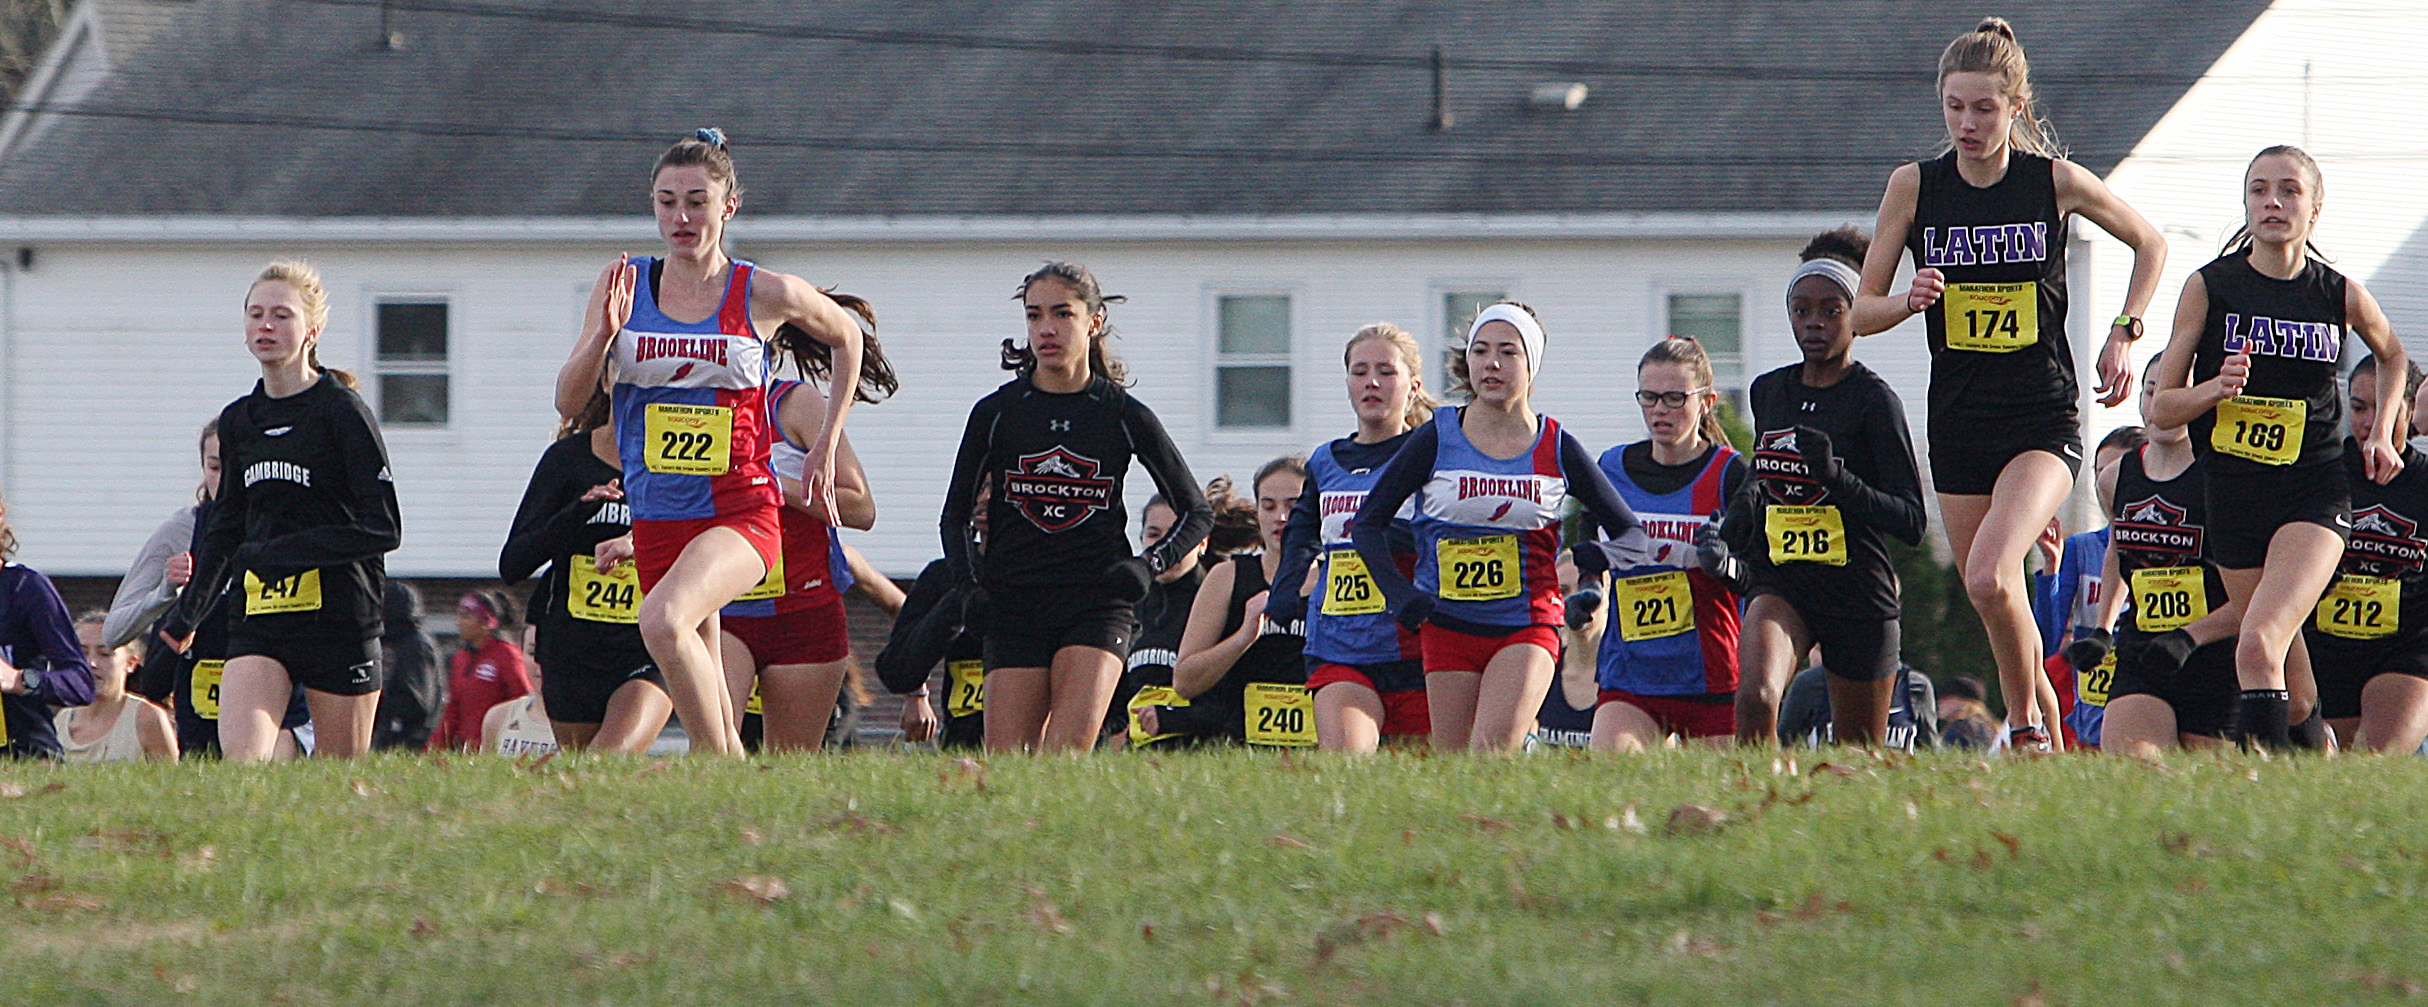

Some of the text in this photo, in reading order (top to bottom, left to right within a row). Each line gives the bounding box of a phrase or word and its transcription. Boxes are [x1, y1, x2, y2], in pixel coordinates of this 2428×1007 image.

[1924, 222, 2047, 265] LATIN
[1964, 310, 2019, 338] 174
[636, 336, 728, 367] BROOKLINE
[2224, 313, 2340, 363] LATIN
[661, 431, 713, 460] 222
[2234, 421, 2286, 451] 169
[244, 461, 311, 488] CAMBRIDGE
[1755, 459, 1809, 475] BROCKT
[1011, 482, 1106, 499] BROCKTON
[1458, 476, 1541, 505] BROOKLINE
[1785, 484, 1804, 496] XC
[1043, 504, 1066, 518] XC
[1782, 529, 1829, 555] 216
[2115, 530, 2194, 547] BROCKTON
[2346, 539, 2420, 560] OCKTON
[1454, 560, 1504, 588] 226
[2360, 562, 2381, 573] XC
[585, 581, 634, 610] 244
[1334, 574, 1370, 601] 225
[1634, 597, 1677, 627] 221
[2145, 591, 2191, 619] 208
[2333, 598, 2383, 627] 212
[1127, 647, 1178, 674] CAMBRIDG
[1258, 707, 1303, 733] 240
